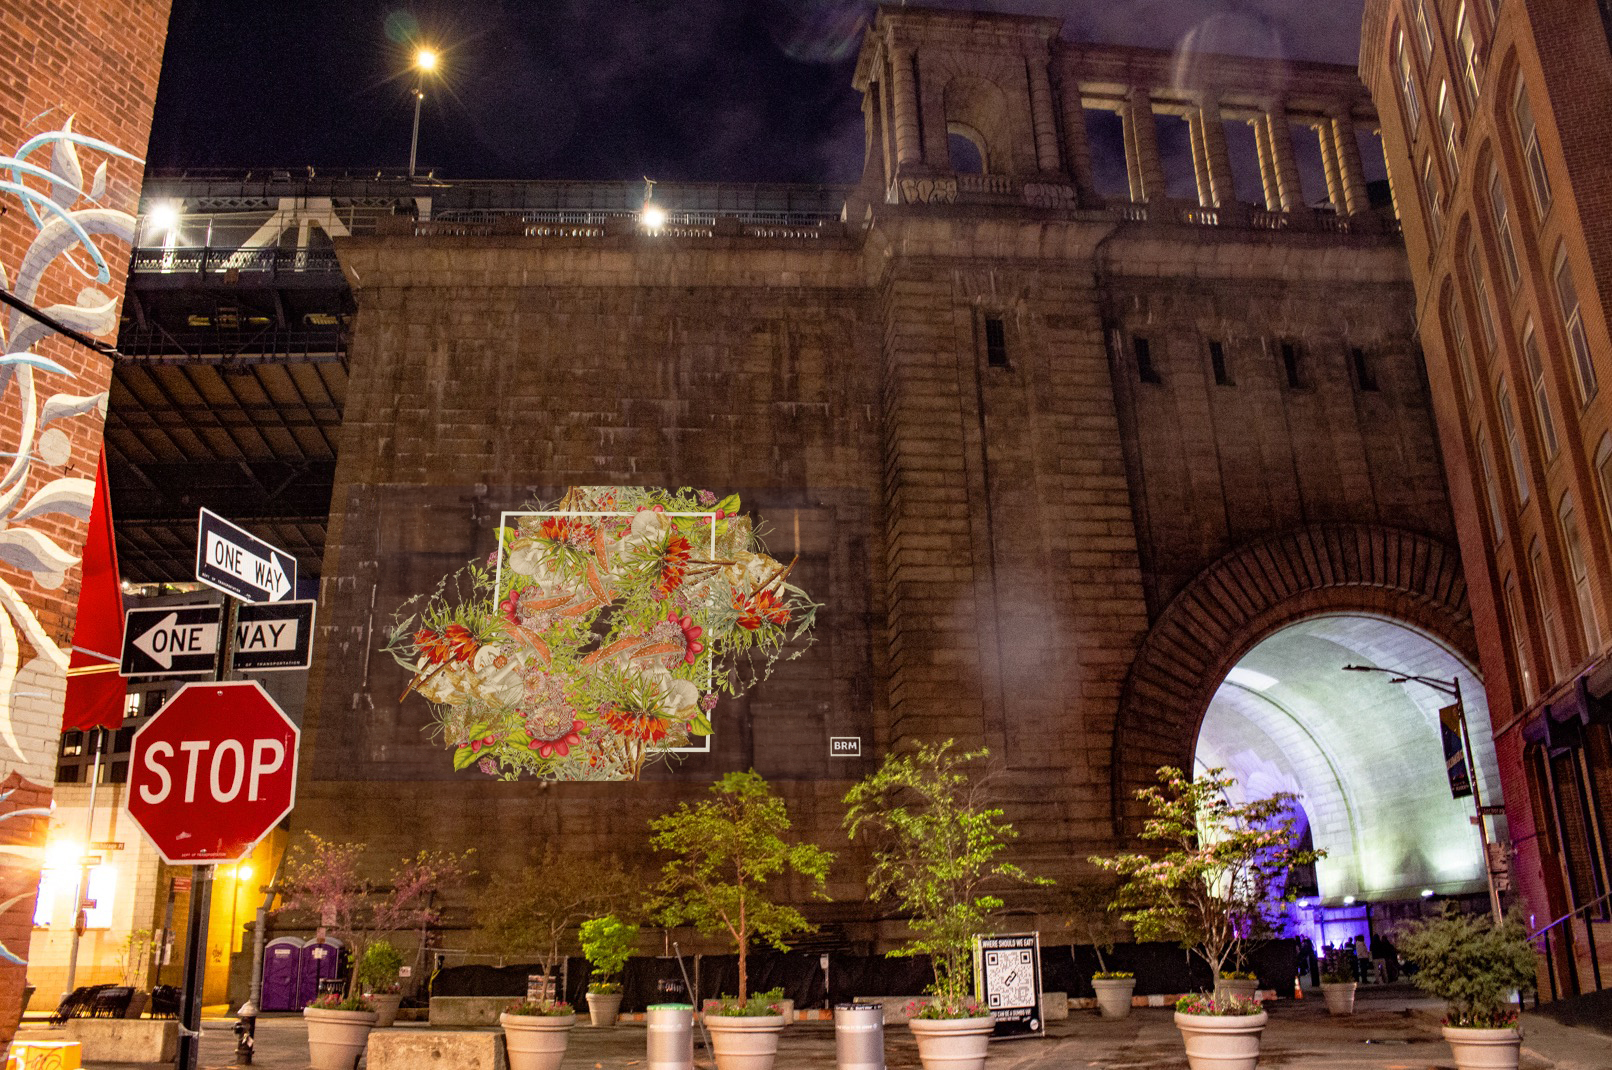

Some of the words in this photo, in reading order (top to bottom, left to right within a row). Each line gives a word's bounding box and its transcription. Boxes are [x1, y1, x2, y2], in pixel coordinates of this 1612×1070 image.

[214, 540, 242, 576] ONE
[255, 560, 283, 593] WAY
[152, 627, 203, 653] ONE
[834, 741, 857, 750] BRM
[139, 738, 285, 804] STOP
[982, 940, 998, 948] WHERE
[998, 939, 1016, 948] SHOULD
[1016, 938, 1023, 947] WE
[1023, 938, 1034, 947] EAT?
